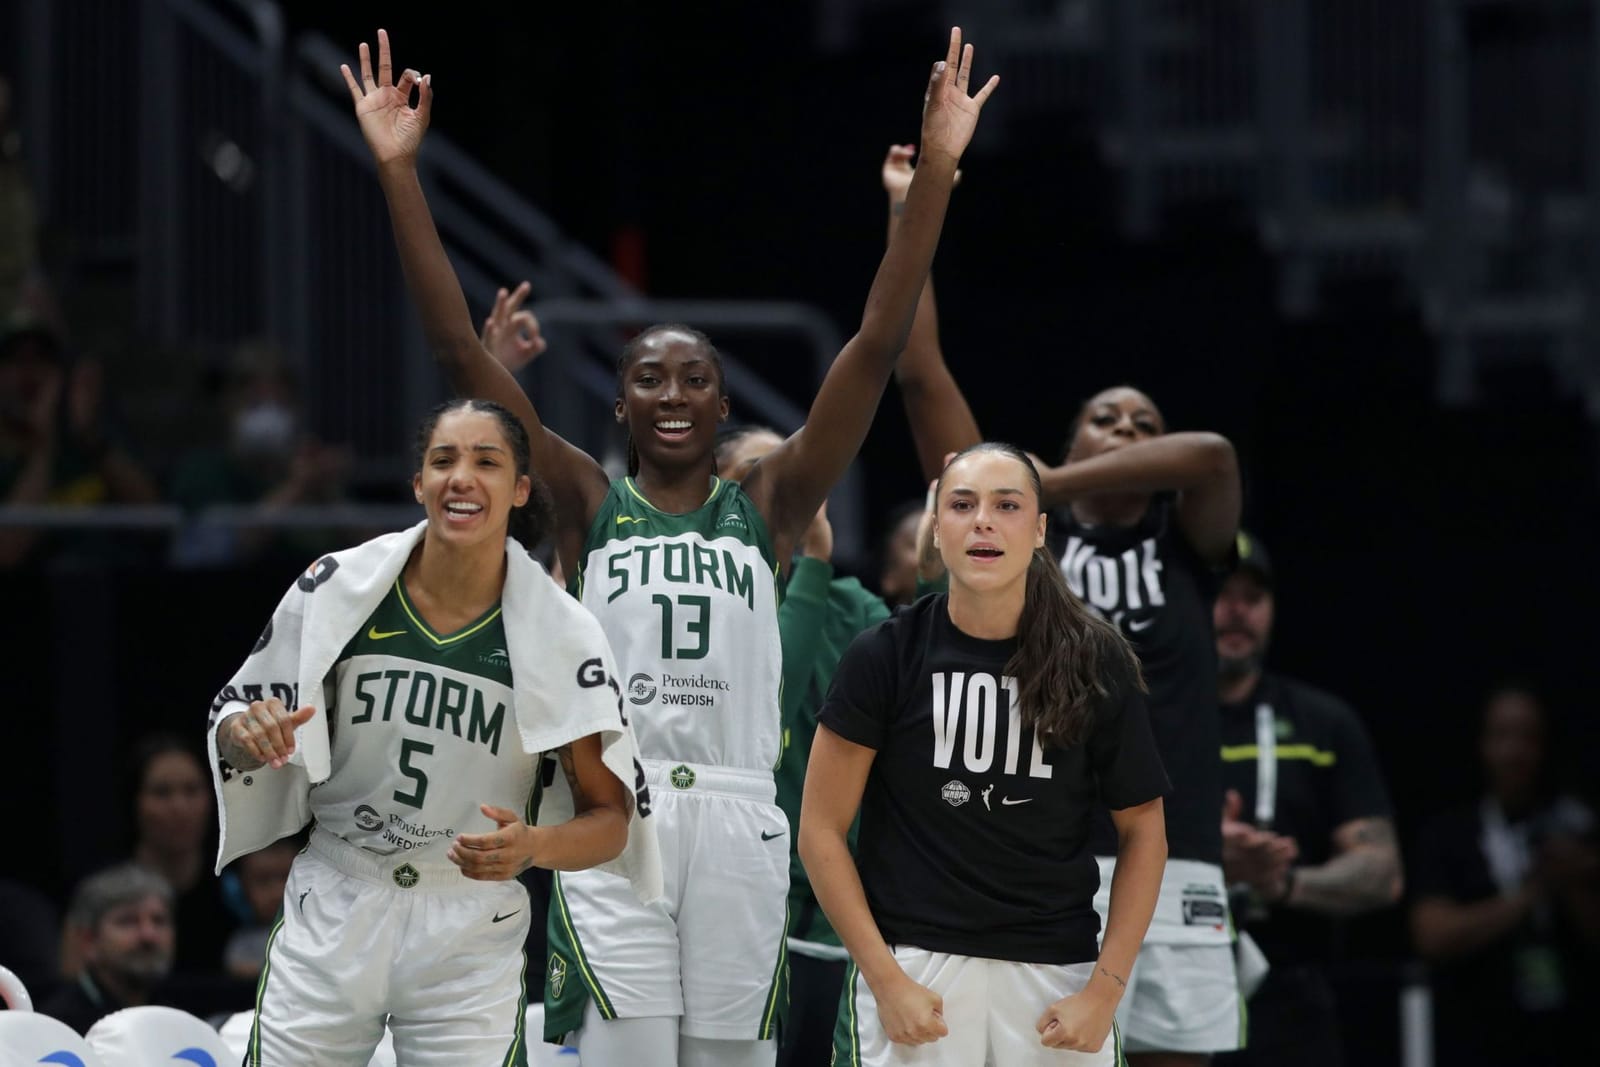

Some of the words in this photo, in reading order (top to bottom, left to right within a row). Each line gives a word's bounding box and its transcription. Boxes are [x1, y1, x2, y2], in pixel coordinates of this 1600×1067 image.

[607, 541, 755, 612] STORM
[651, 593, 712, 661] 13
[351, 669, 506, 757] STORM
[661, 693, 715, 707] SWEDISH
[393, 737, 435, 810] 5
